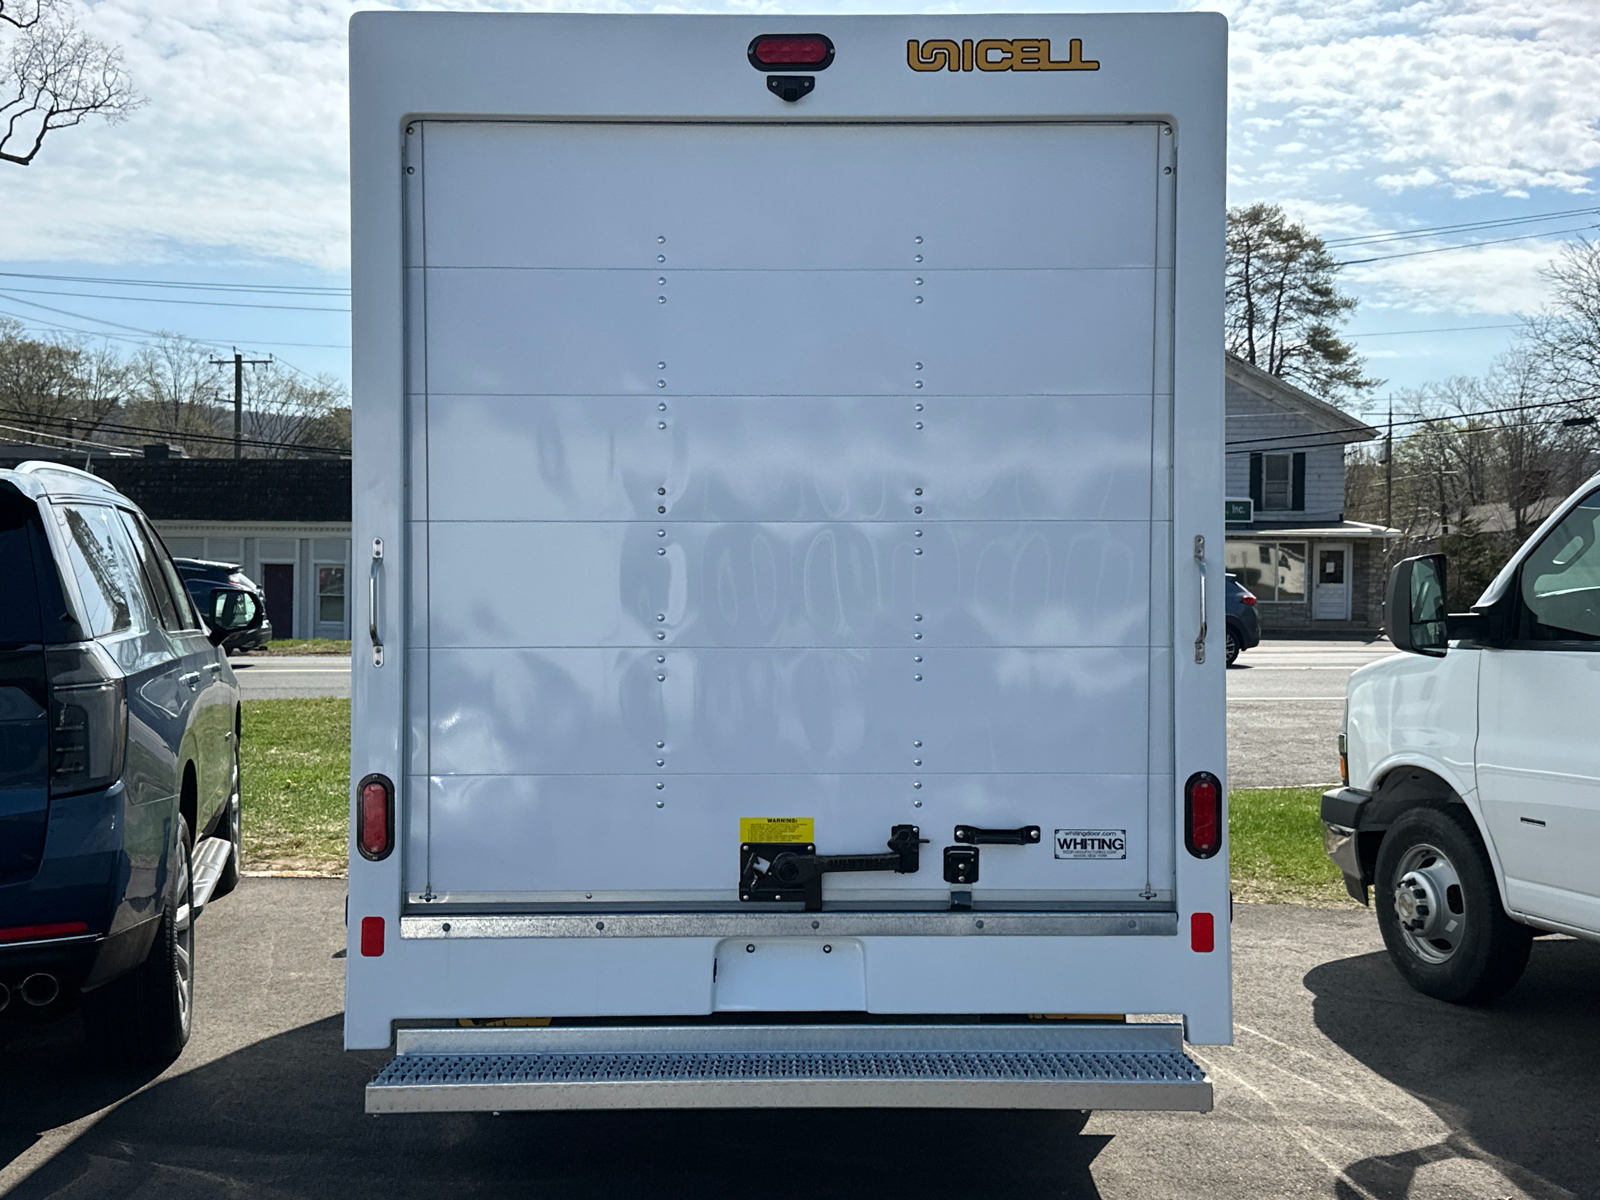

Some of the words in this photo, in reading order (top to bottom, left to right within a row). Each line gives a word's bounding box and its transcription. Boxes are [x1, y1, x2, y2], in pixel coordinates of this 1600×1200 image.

[907, 39, 1100, 72] UNICELL
[1232, 504, 1246, 514] Inc.
[1057, 838, 1124, 850] WHITING
